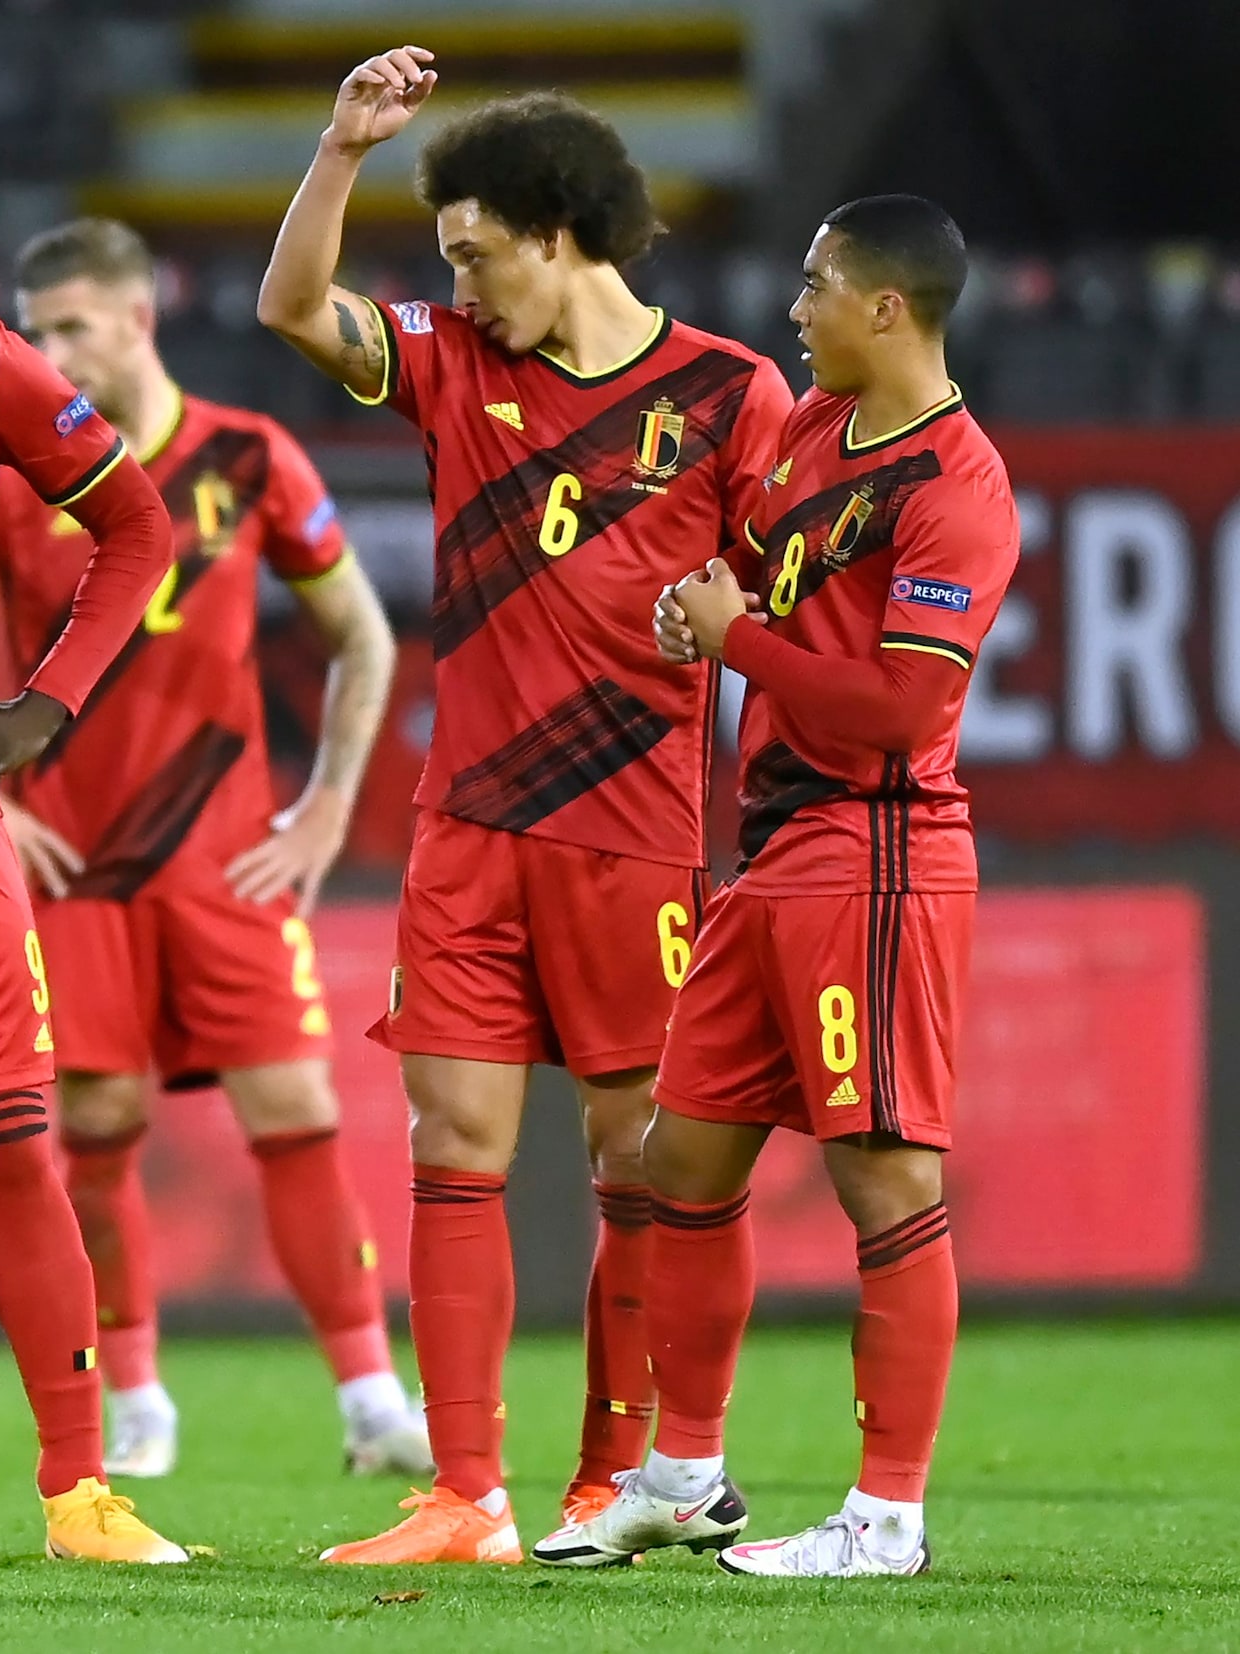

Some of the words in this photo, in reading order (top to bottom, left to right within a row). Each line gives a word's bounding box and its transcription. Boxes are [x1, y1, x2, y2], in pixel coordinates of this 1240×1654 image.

[538, 472, 582, 557] 6
[769, 532, 805, 617] 8
[913, 584, 971, 606] RESPECT
[24, 929, 50, 1015] 9
[656, 901, 694, 990] 6
[818, 984, 858, 1074] 8
